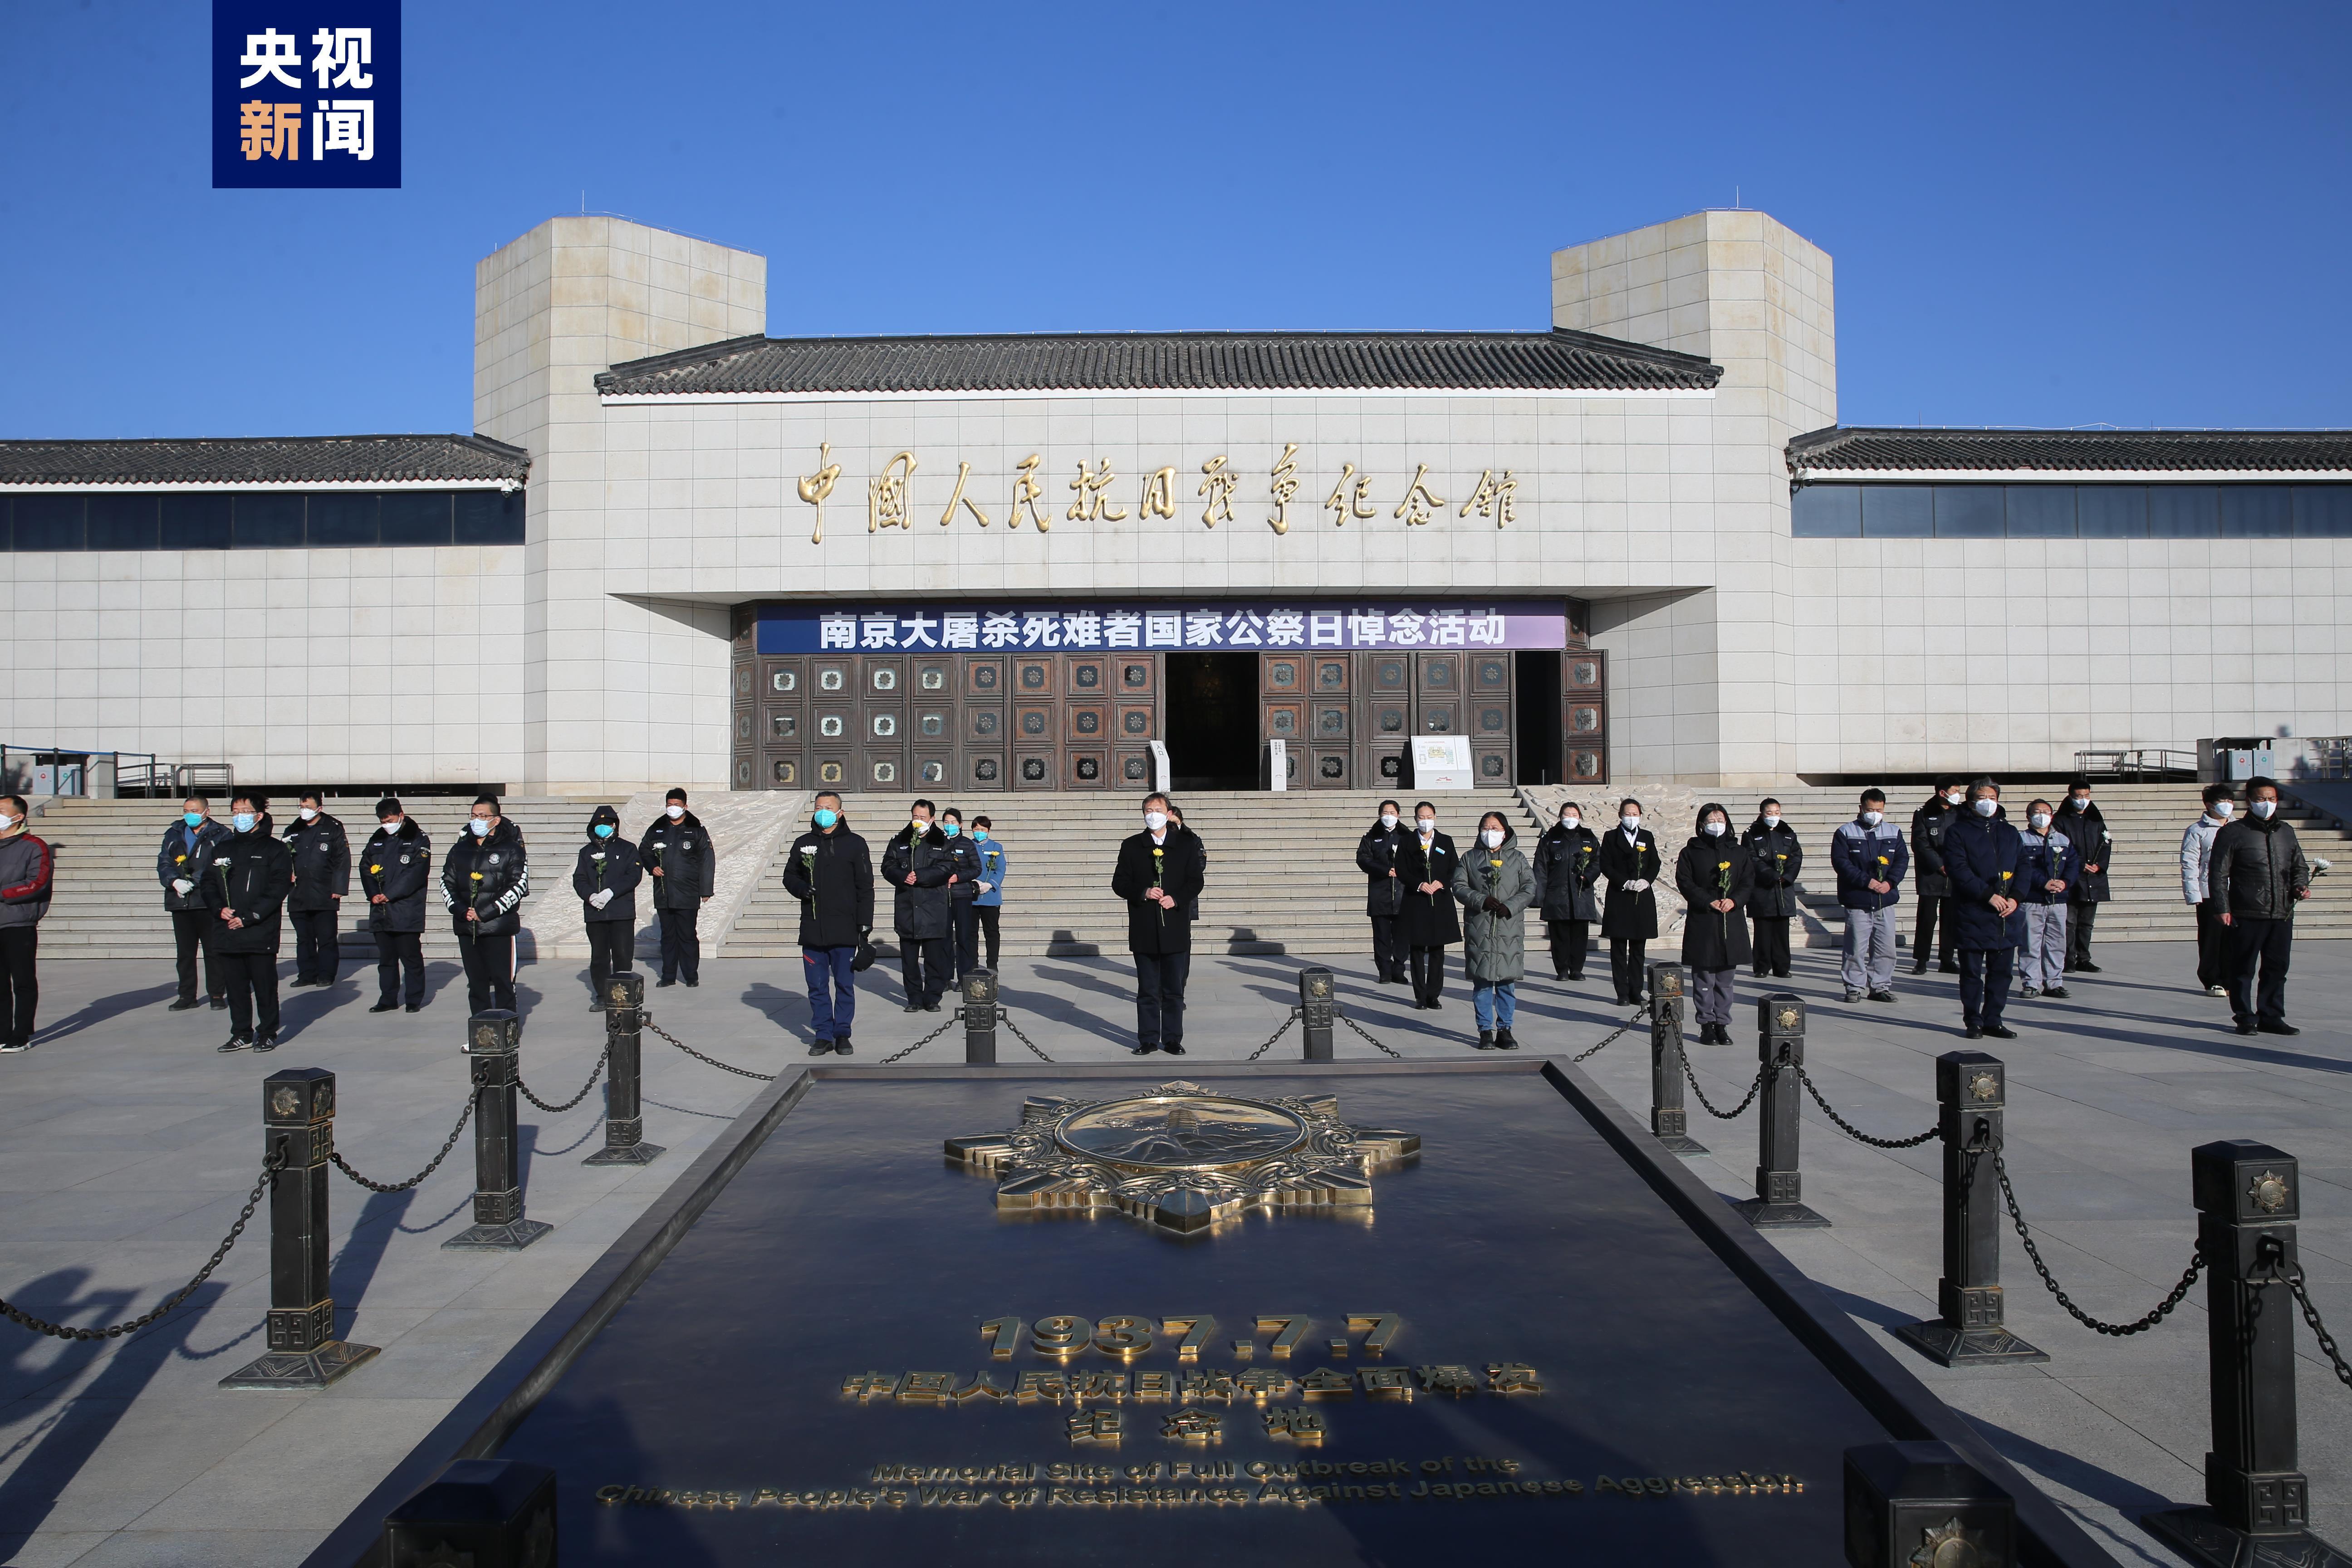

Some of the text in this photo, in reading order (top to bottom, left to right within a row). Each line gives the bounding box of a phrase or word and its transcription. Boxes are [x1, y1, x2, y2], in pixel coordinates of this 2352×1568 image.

[819, 608, 1505, 649] 南京大屠杀死难者国家公祭日悼念活动
[1156, 744, 1164, 756] 入口
[980, 1313, 1400, 1356] 1937.7.7
[841, 1362, 1543, 1401] 中国人民抗日战争全面爆发
[1065, 1406, 1327, 1441] 纪念地
[871, 1455, 1520, 1481] Memorial Site of Full Outbreak of the
[595, 1470, 1804, 1509] Chinese People's War of Resistance Against Japanese Aggression
